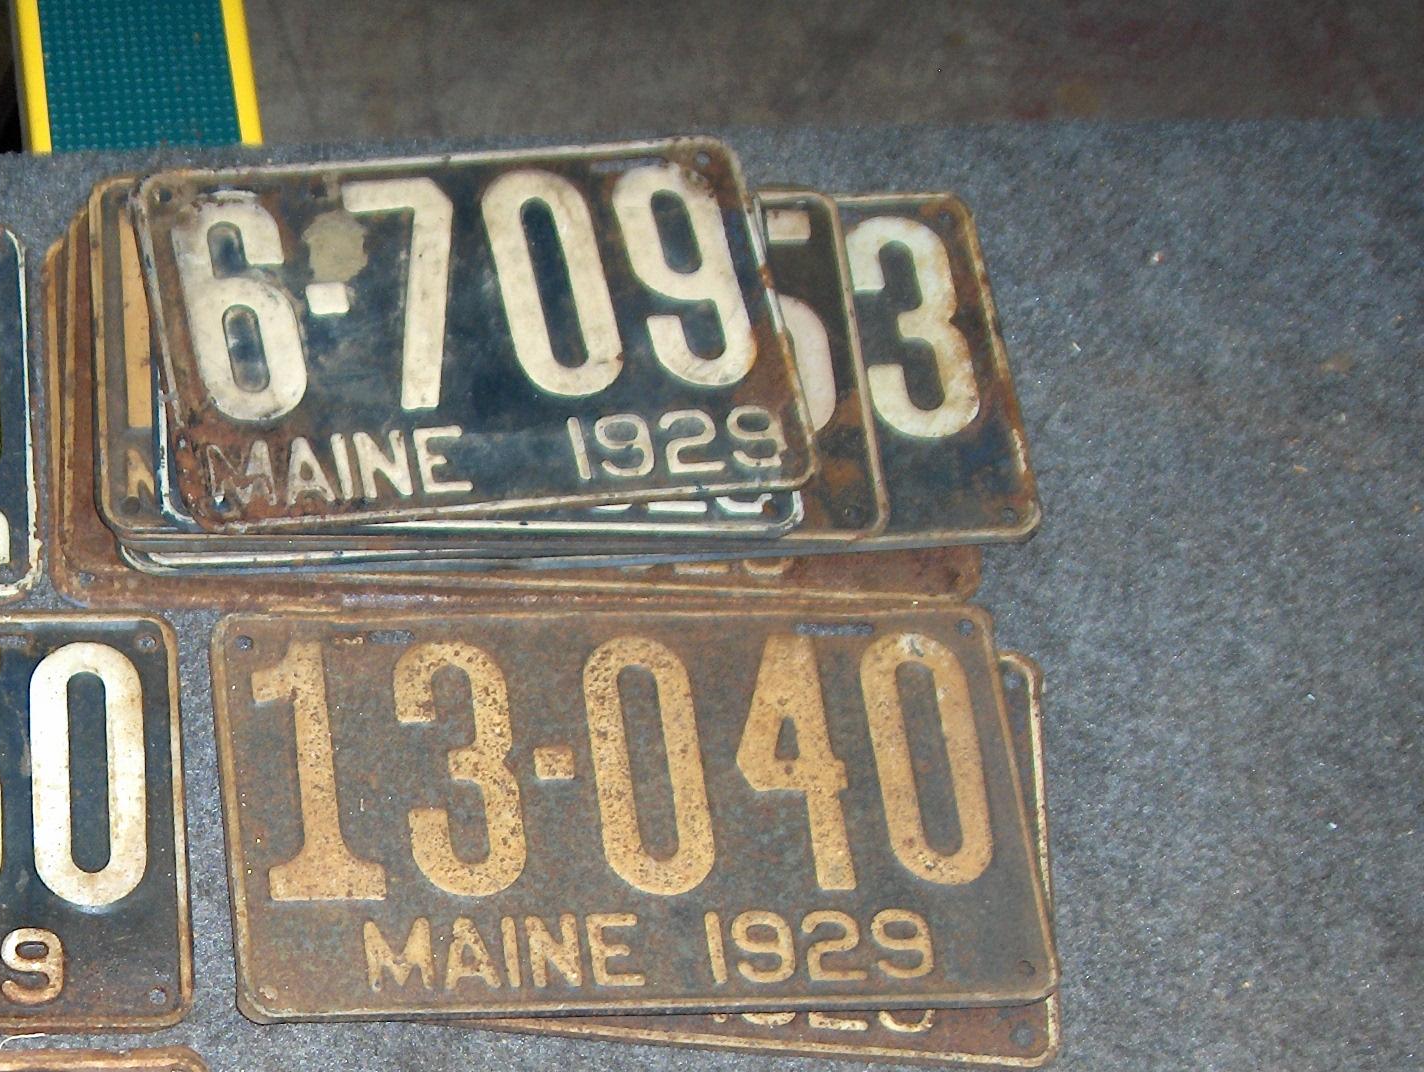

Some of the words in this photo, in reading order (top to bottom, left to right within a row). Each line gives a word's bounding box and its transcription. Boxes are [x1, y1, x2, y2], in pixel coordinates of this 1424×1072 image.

[173, 163, 756, 423] 6-709
[206, 424, 474, 507] MAINE
[566, 405, 788, 480] 1929
[250, 631, 994, 903] 13-040
[361, 912, 646, 991] MAINE
[705, 909, 935, 986] 1929
